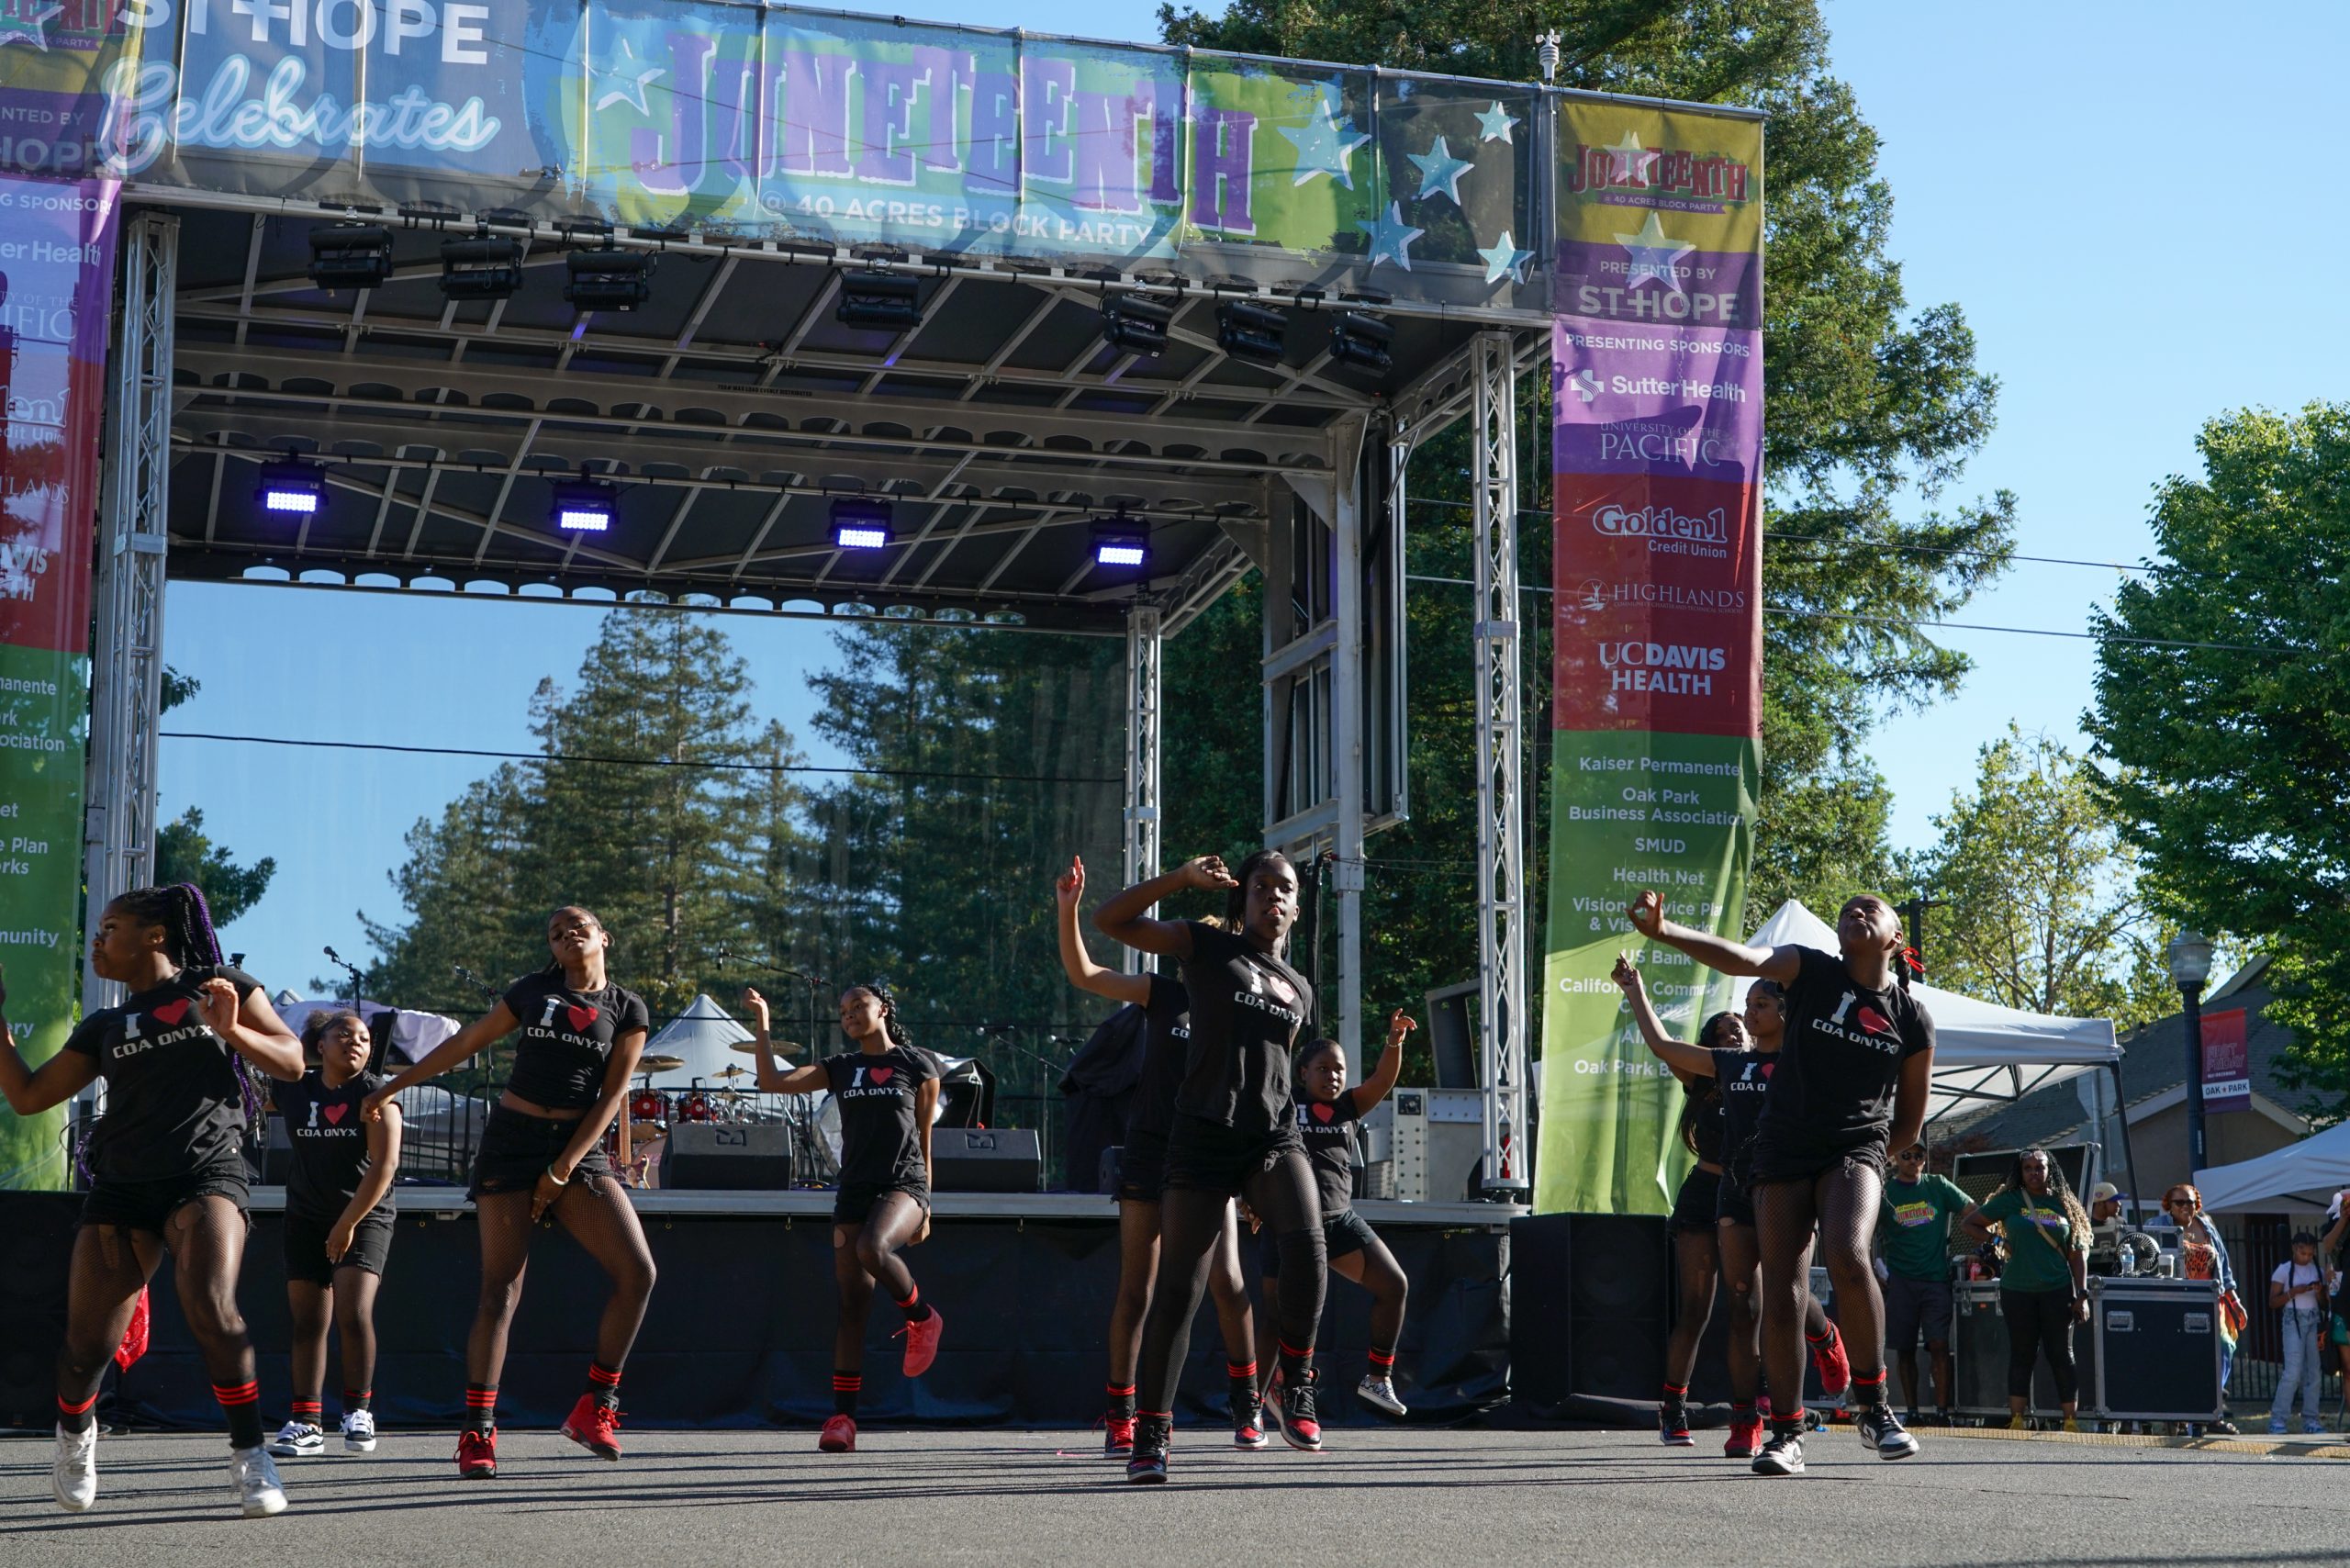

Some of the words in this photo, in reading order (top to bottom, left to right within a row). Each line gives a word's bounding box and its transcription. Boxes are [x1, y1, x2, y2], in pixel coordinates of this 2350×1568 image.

[61, 112, 84, 126] BY
[97, 52, 501, 174] Celebrates
[631, 30, 1258, 237] JUNETEENTH
[1615, 196, 1626, 204] 40
[1628, 197, 1656, 207] ACRES
[1659, 200, 1687, 210] BLOCK
[1689, 203, 1719, 212] PARTY
[796, 195, 834, 218] 40
[845, 199, 942, 227] ACRES
[953, 207, 1049, 239] BLOCK
[1058, 220, 1153, 247] PARTY
[32, 241, 101, 267] Health
[1600, 261, 1691, 278] PRESENTED
[1696, 267, 1717, 279] BY
[1566, 333, 1664, 350] PRESENTING
[1670, 341, 1750, 357] SPONSORS
[1612, 375, 1679, 397] Sutter
[1682, 380, 1745, 402] Health
[1600, 421, 1674, 434] UNIVERSITY
[1677, 426, 1695, 436] OF
[1700, 427, 1720, 439] THE
[1600, 433, 1720, 466] PACIFIC
[1649, 540, 1687, 554] Credit
[1691, 543, 1727, 558] Union
[1614, 584, 1745, 608] HIGHLANDS
[1612, 670, 1711, 695] HEALTH
[1580, 757, 1634, 771] Kaiser
[1640, 757, 1740, 776] Permanente
[1622, 788, 1657, 802] Oak
[1662, 790, 1699, 804] Park
[1569, 806, 1645, 821] Business
[1651, 808, 1745, 826] Association
[12, 837, 48, 853] Plan
[1635, 837, 1685, 854] SMUD
[1614, 868, 1670, 884] Health
[1675, 871, 1705, 886] Net
[1572, 897, 1627, 912] Vision
[1589, 918, 1601, 931] &
[1624, 949, 1645, 962] US
[1652, 950, 1692, 965] Bank
[1249, 961, 1263, 994] I
[1234, 991, 1265, 1010] COA
[1830, 991, 1856, 1025] I
[540, 998, 560, 1026] I
[125, 1013, 141, 1039] I
[112, 1038, 153, 1058] COA
[159, 1025, 214, 1046] ONYX
[527, 1026, 556, 1038] COA
[561, 1033, 605, 1052] ONYX
[1812, 1018, 1844, 1038] COA
[1850, 1031, 1899, 1055] ONYX
[1574, 1059, 1608, 1074] Oak
[1613, 1059, 1652, 1075] Park
[1740, 1062, 1758, 1081] I
[852, 1067, 865, 1087] I
[844, 1088, 865, 1099] COA
[868, 1087, 903, 1096] ONYX
[1730, 1082, 1754, 1092] COA
[2205, 1086, 2221, 1095] OAK
[2229, 1082, 2247, 1092] PARK
[308, 1102, 319, 1126] I
[1297, 1104, 1308, 1124] I
[297, 1127, 321, 1137] COA
[324, 1127, 357, 1137] ONYX
[1315, 1126, 1348, 1134] ONYX
